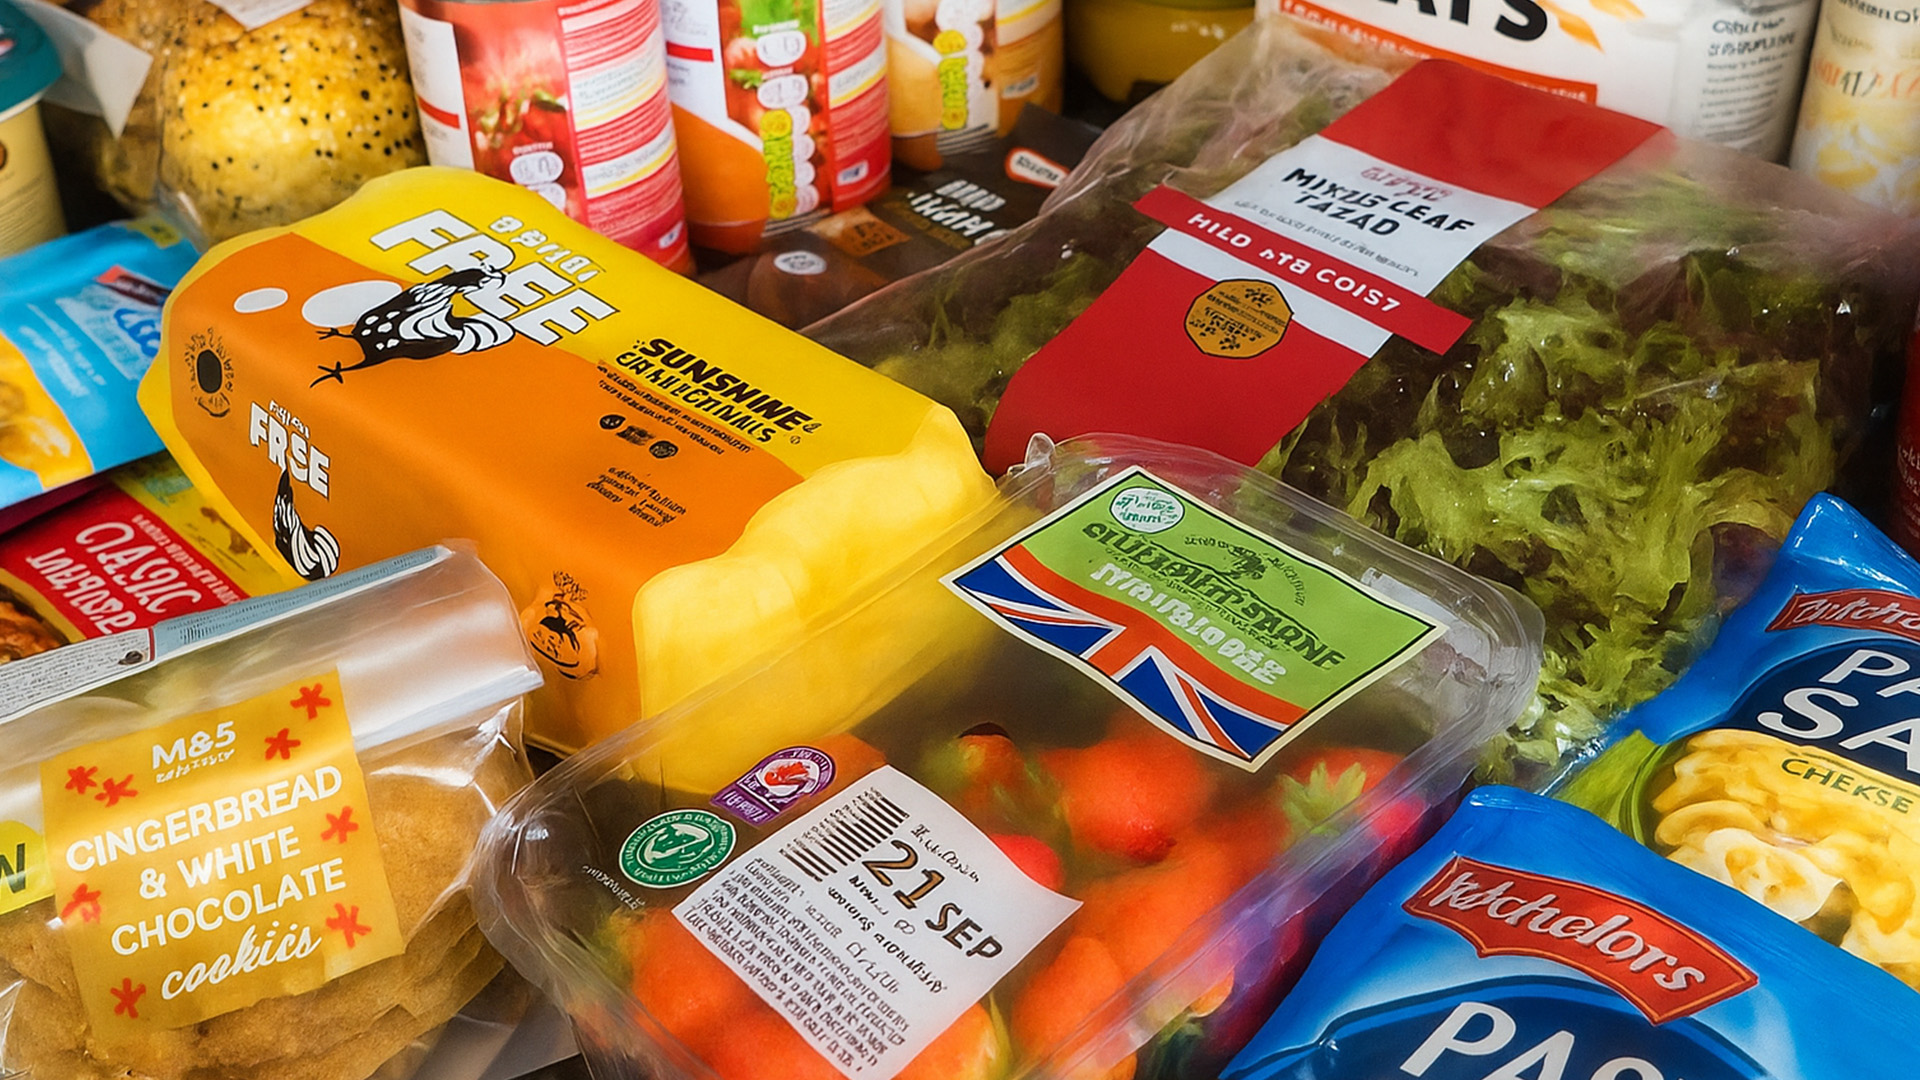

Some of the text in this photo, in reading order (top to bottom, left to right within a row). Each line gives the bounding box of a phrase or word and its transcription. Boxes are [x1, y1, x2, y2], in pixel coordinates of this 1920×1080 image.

[369, 208, 621, 347] FREE
[111, 858, 347, 955] CHOCOLATE
[139, 826, 300, 900] & WHITE
[862, 839, 946, 910] 21
[925, 902, 1003, 961] SEP
